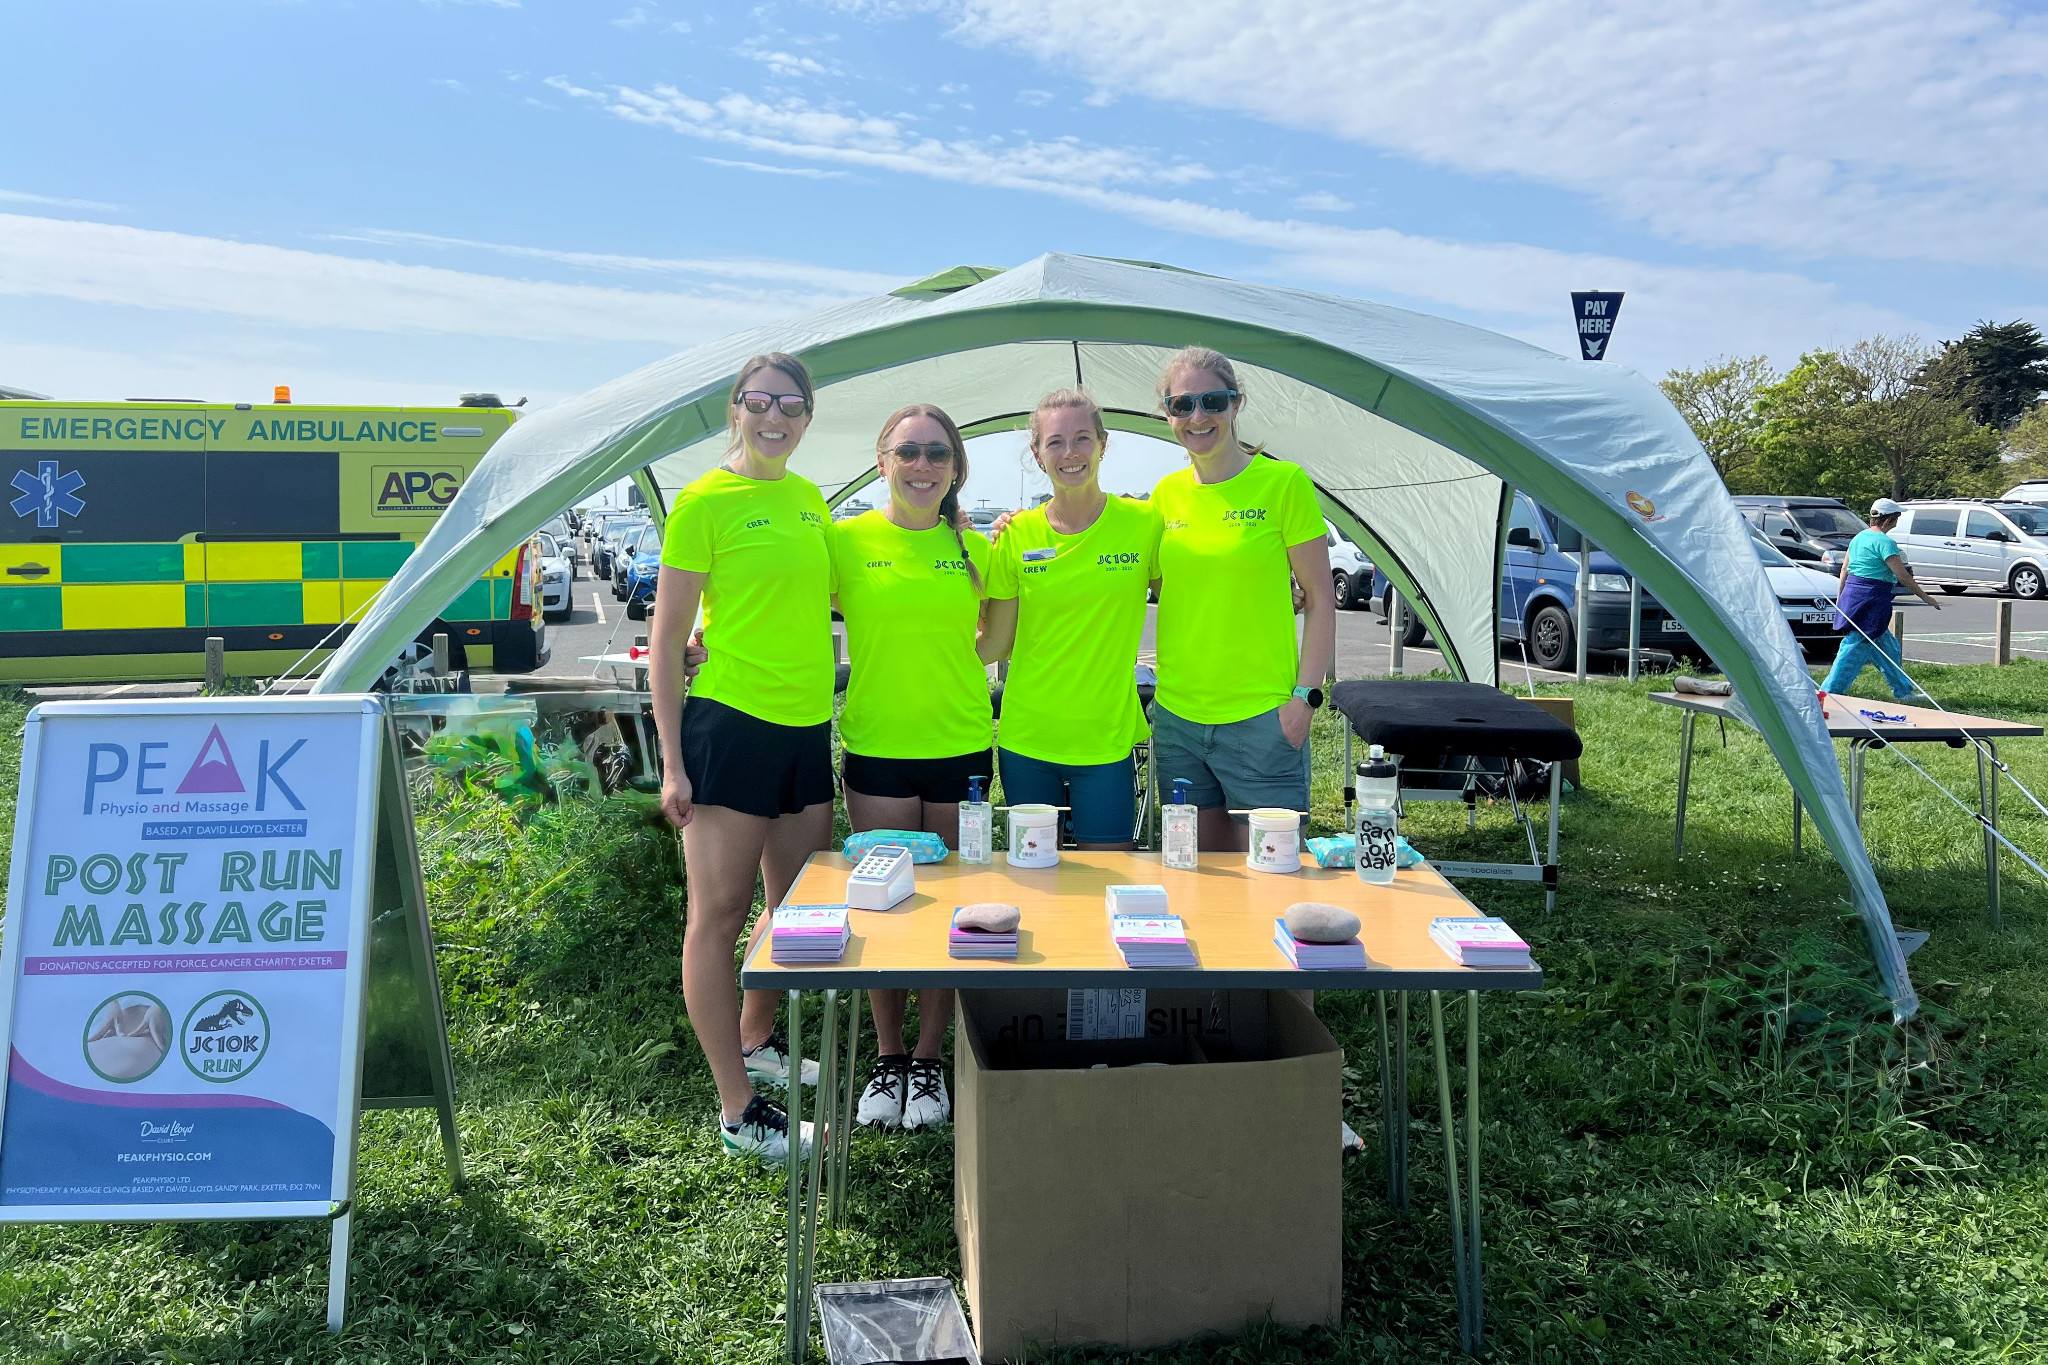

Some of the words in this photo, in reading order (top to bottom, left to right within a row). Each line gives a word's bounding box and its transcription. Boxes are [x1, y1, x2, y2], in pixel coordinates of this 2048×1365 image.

[1584, 300, 1608, 315] PAY
[1579, 318, 1611, 333] HERE
[20, 417, 226, 440] EMERGENCY
[247, 419, 437, 442] AMBULANCE
[378, 472, 460, 504] APG
[1222, 508, 1267, 521] JC10K
[746, 518, 770, 529] CREW
[866, 560, 893, 568] CREW
[934, 559, 968, 571] JC10
[1097, 552, 1140, 565] JC10K
[1023, 565, 1048, 574] CREW
[1805, 613, 1826, 622] WF25
[1665, 621, 1685, 631] LS5
[83, 722, 309, 815] PEAK
[100, 801, 148, 816] Physio
[152, 801, 180, 813] and
[185, 801, 249, 814] Massage
[145, 826, 178, 836] BASED
[180, 825, 192, 834] AT
[196, 825, 227, 835] DAVID
[265, 823, 304, 833] EXETER
[1360, 852, 1396, 870] dale
[45, 852, 188, 896] POST
[219, 848, 342, 892] RUN
[1470, 867, 1514, 875] specialists
[785, 911, 840, 919] PEAK
[52, 899, 327, 947] MASSAGE
[1120, 920, 1177, 928] PEAK
[39, 961, 100, 971] DONATIONS
[100, 960, 151, 970] ACCEPTED
[153, 959, 173, 968] FOR
[210, 958, 251, 967] CANCER
[298, 956, 333, 966] EXETER
[1133, 989, 1142, 1004] BOX
[189, 1034, 259, 1054] JC10K
[203, 1058, 242, 1073] RUN
[140, 1120, 171, 1137] David
[169, 1120, 195, 1137] Lloyd
[117, 1152, 212, 1162] PEAKPHYSIO.COM
[133, 1176, 176, 1184] PEAKPHYSIO
[69, 1186, 102, 1194] MASSAGE
[165, 1185, 188, 1193] DAVID
[289, 1183, 304, 1191] EX2
[304, 1183, 321, 1191] 7NN
